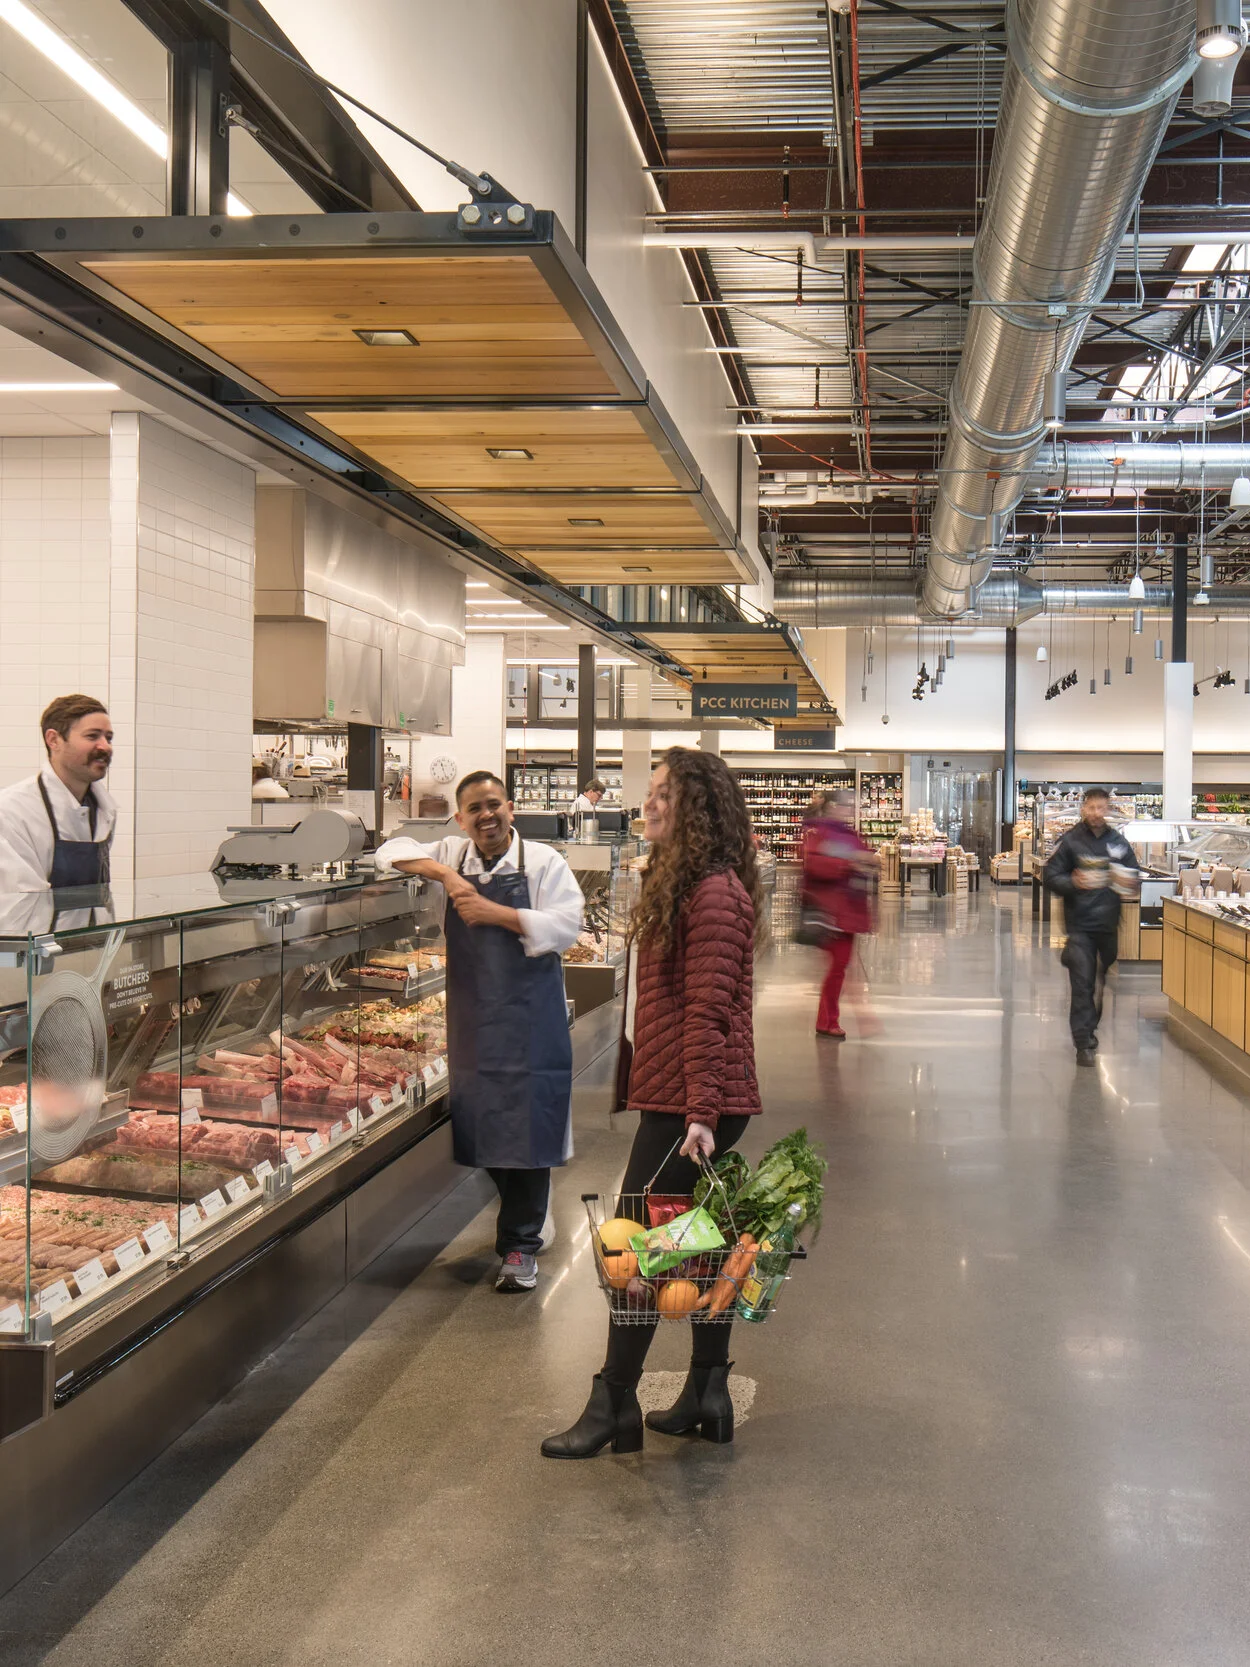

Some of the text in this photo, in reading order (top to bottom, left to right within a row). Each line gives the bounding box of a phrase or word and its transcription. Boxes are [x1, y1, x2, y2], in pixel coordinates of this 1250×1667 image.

[700, 697, 790, 709] PCC KITCHEN
[778, 738, 813, 746] CHEESE
[113, 970, 150, 990] BUTCHERS
